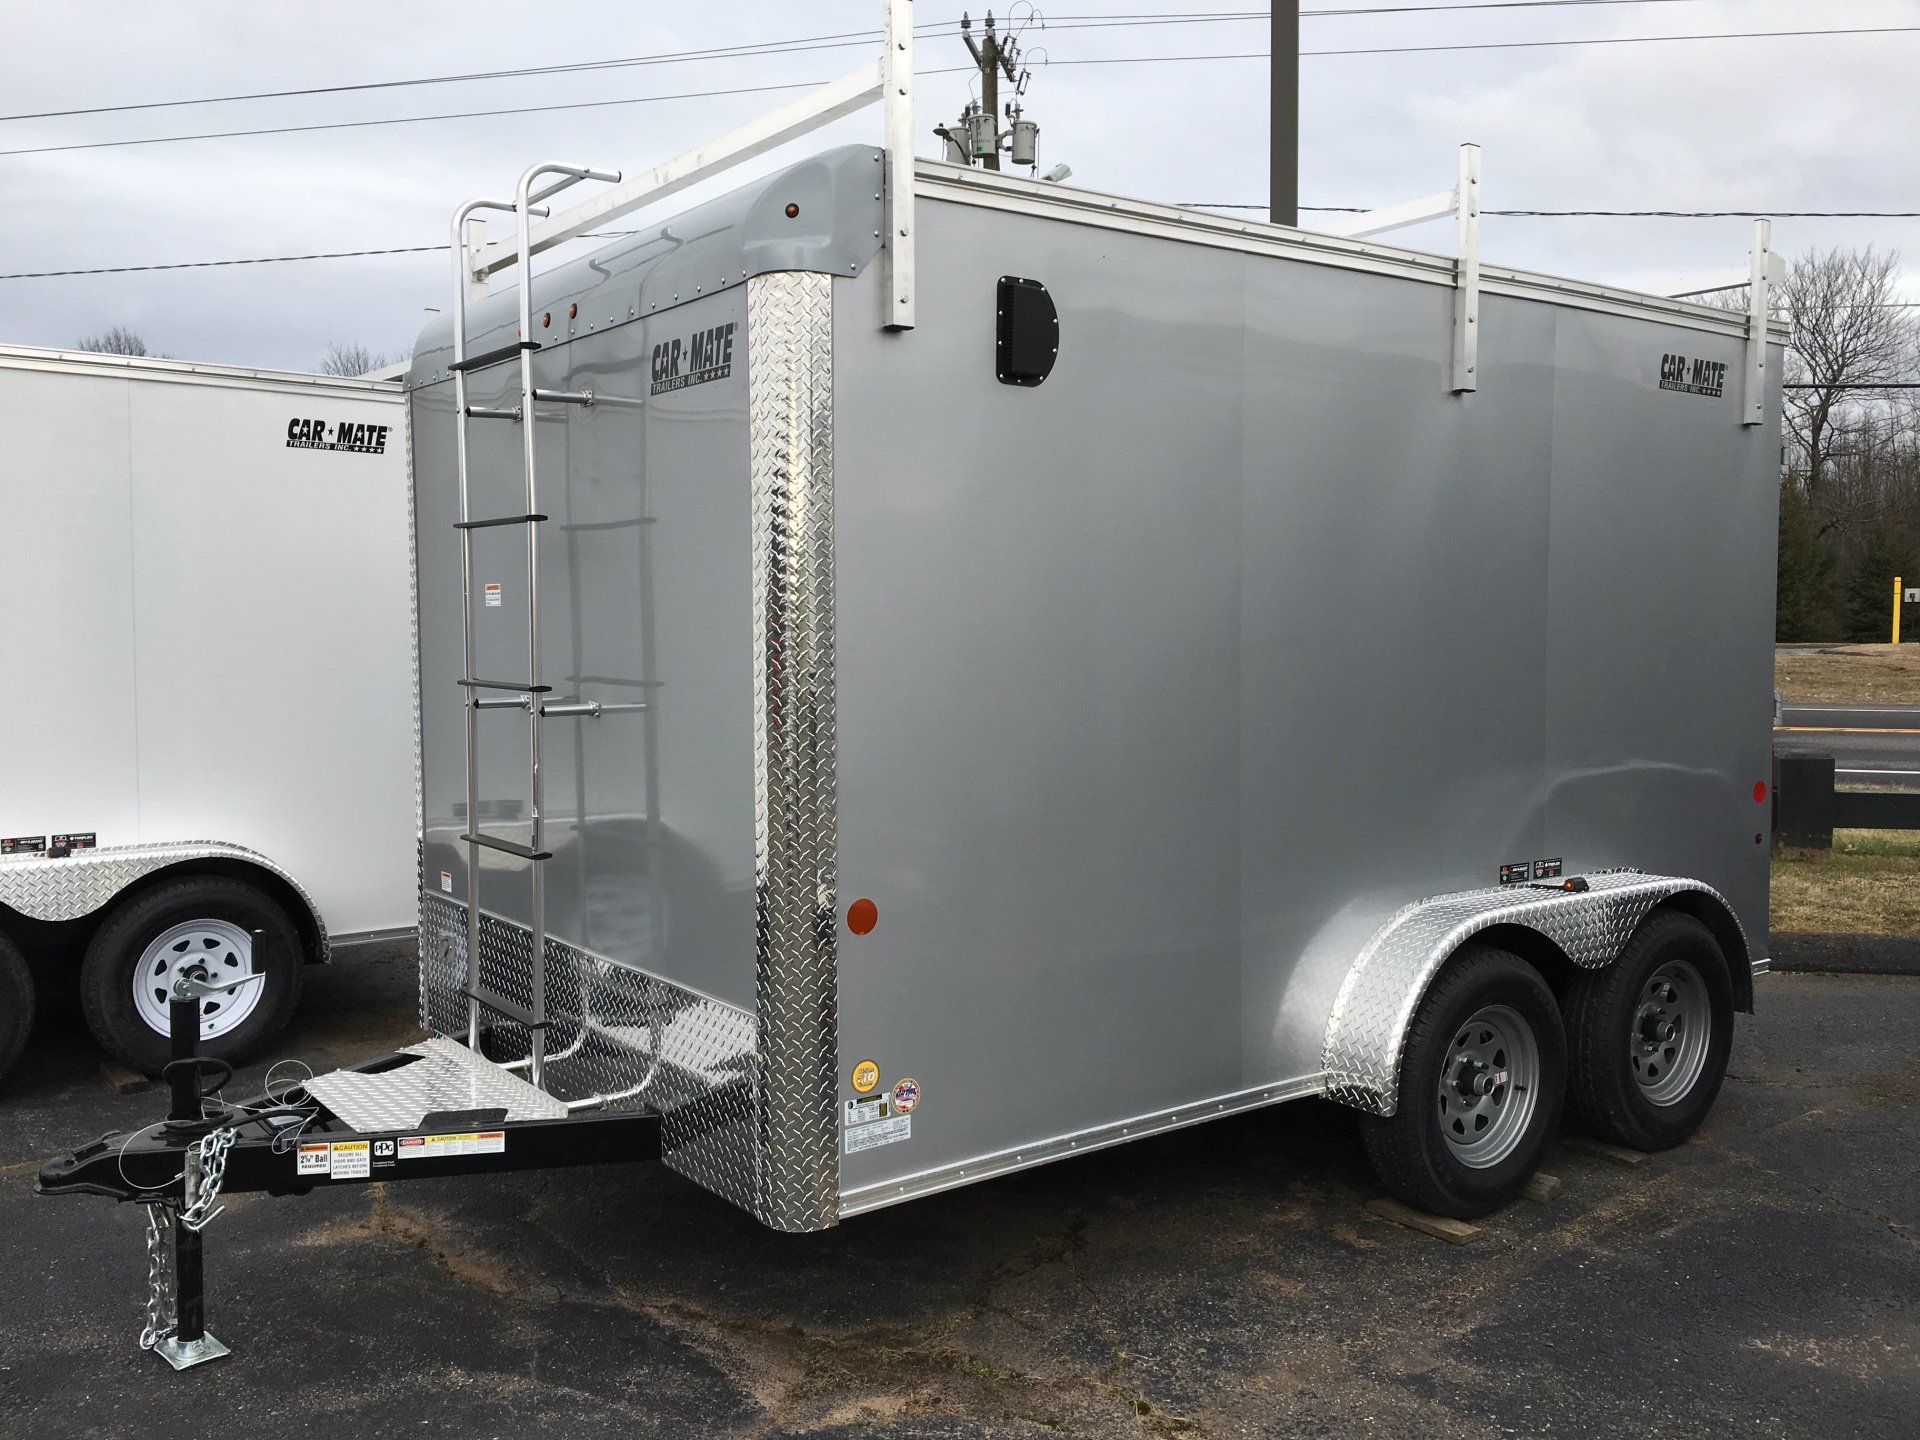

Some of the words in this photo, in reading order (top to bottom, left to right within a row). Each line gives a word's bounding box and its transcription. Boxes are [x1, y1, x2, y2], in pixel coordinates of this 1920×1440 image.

[652, 339, 681, 382] CAR
[690, 322, 734, 373] MATE
[1661, 353, 1685, 382] CAR
[1692, 358, 1725, 388] MATE
[652, 377, 685, 395] TRAILERS
[687, 373, 702, 385] INC.
[1660, 380, 1688, 392] TRAILERS
[287, 418, 326, 441] CAR
[337, 421, 388, 447] MATE
[288, 440, 331, 450] TRAILERS
[334, 443, 352, 452] INC.
[375, 1143, 393, 1154] PPG
[315, 1154, 328, 1163] Ball
